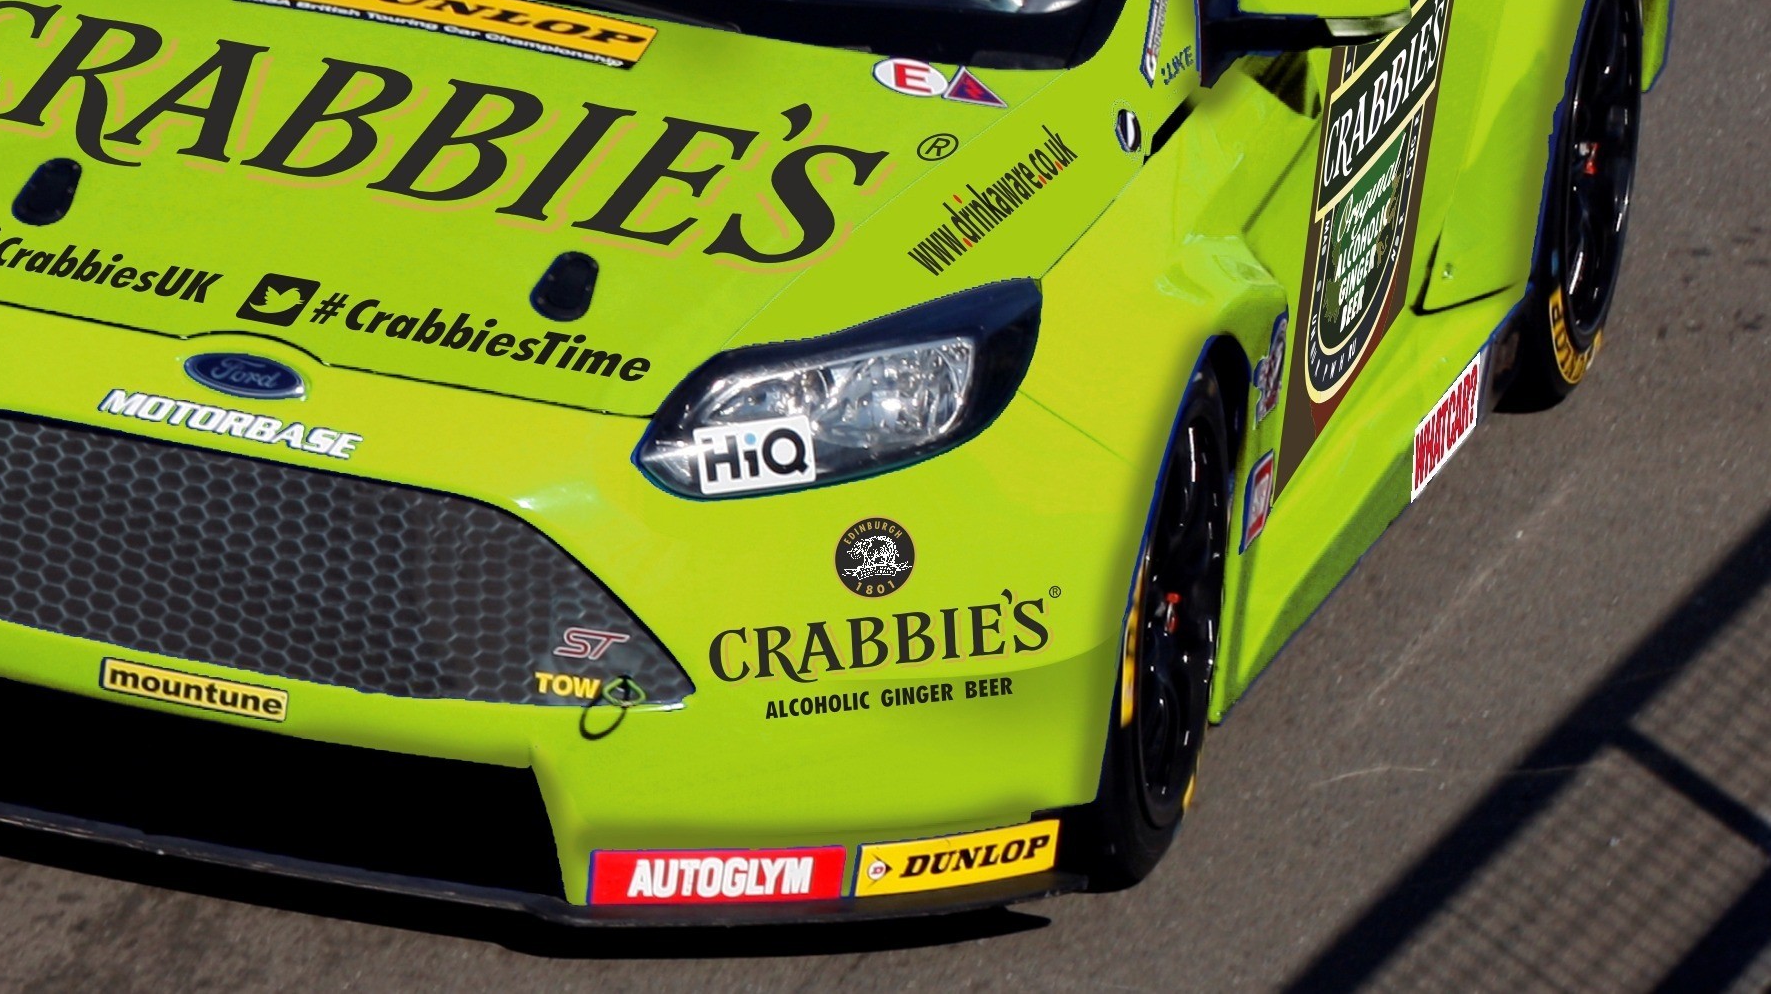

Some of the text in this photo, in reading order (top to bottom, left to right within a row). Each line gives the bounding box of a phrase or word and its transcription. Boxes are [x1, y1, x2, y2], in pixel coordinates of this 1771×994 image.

[296, 0, 361, 18] British
[366, 10, 439, 31] Touring
[442, 23, 482, 39] Car
[484, 31, 625, 67] Championship
[907, 124, 1079, 277] www.drinkaware.co.uk
[1335, 199, 1392, 282] ALCOHOLIC
[1338, 241, 1377, 306] GINGER
[1339, 284, 1365, 333] BEER
[310, 292, 652, 383] #CrabbiesTime
[211, 357, 282, 390] Ford
[98, 389, 364, 459] MOTORBASE
[700, 428, 810, 482] HiQ
[843, 521, 903, 545] EDINBURGH
[856, 580, 895, 595] 1801
[553, 627, 630, 660] ST
[709, 588, 1051, 683] CRABBIE'S
[109, 665, 284, 717] mountune
[535, 672, 602, 699] TOW
[766, 677, 1014, 720] ALCOHOLIC GINGER BEER
[627, 856, 815, 899] AUTOGLYM
[899, 833, 1051, 879] DUNLOP
